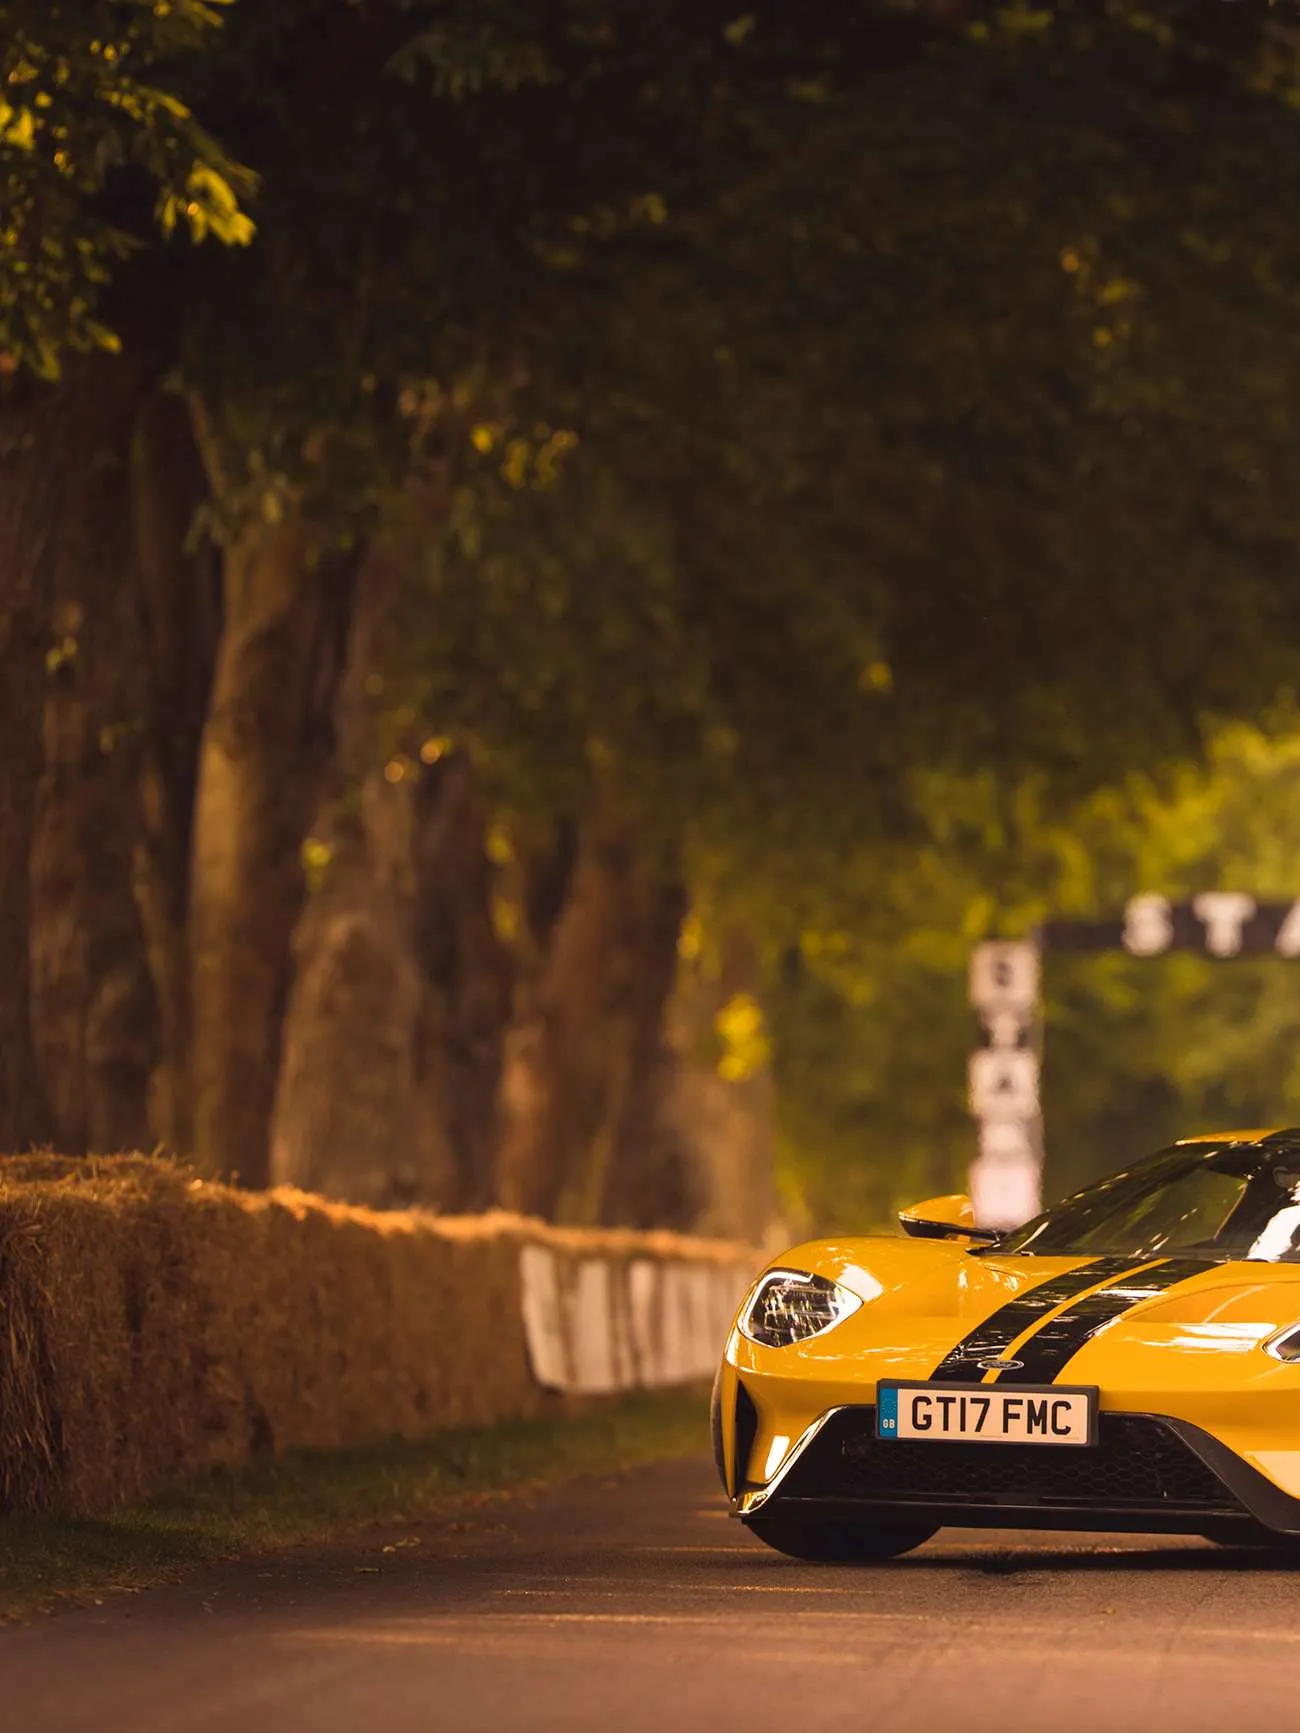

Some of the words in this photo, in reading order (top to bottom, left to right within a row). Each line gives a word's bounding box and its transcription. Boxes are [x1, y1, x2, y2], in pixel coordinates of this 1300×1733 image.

[882, 1418, 895, 1429] GB
[912, 1396, 990, 1432] GT17
[1003, 1399, 1072, 1435] FMC
